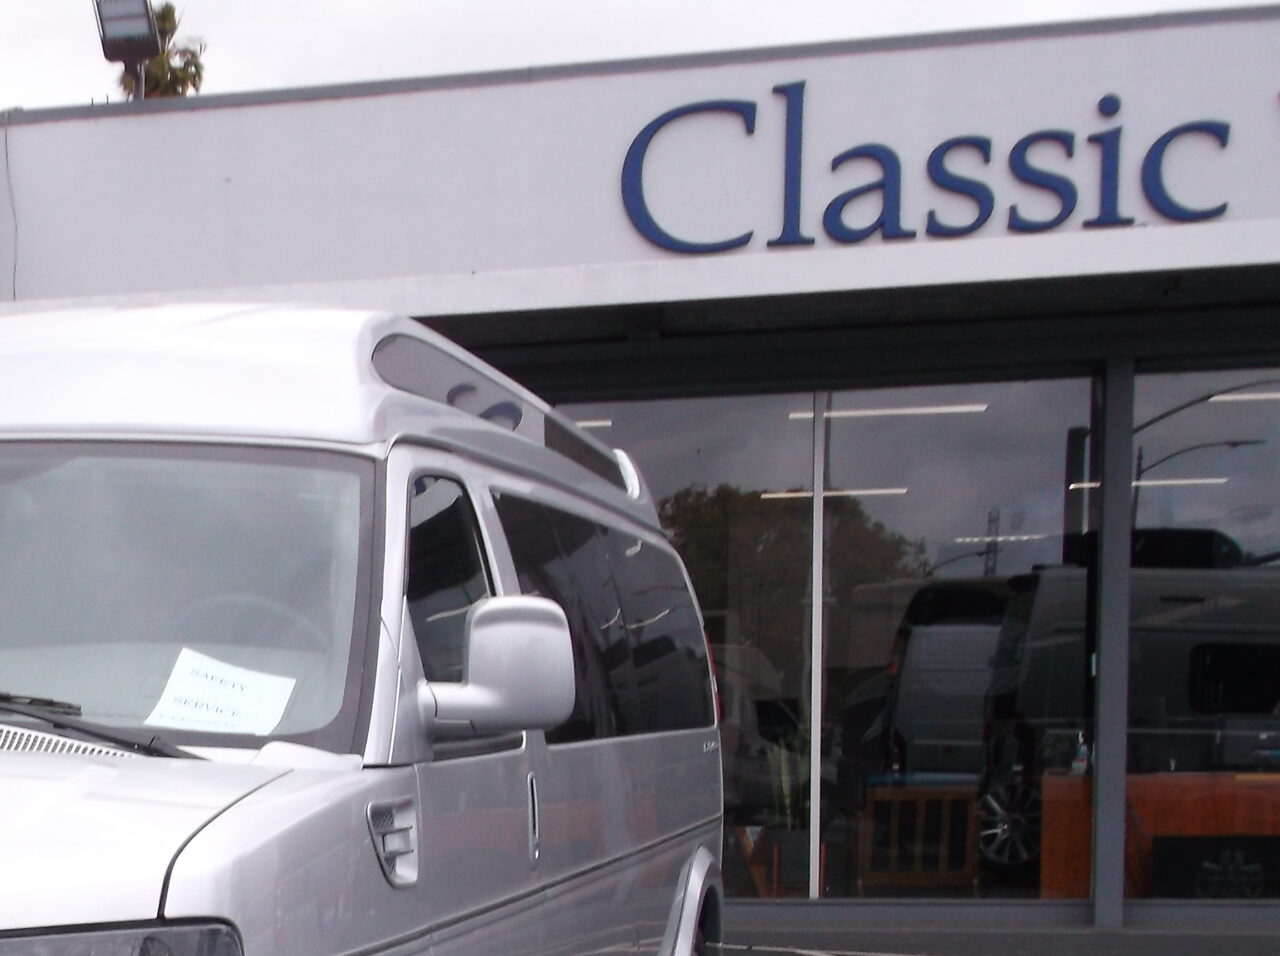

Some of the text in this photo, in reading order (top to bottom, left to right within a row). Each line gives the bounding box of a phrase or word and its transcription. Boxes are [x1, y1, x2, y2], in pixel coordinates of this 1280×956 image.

[621, 80, 1231, 255] Classic
[190, 668, 248, 692] SAFETY
[172, 696, 241, 718] SERVICE
